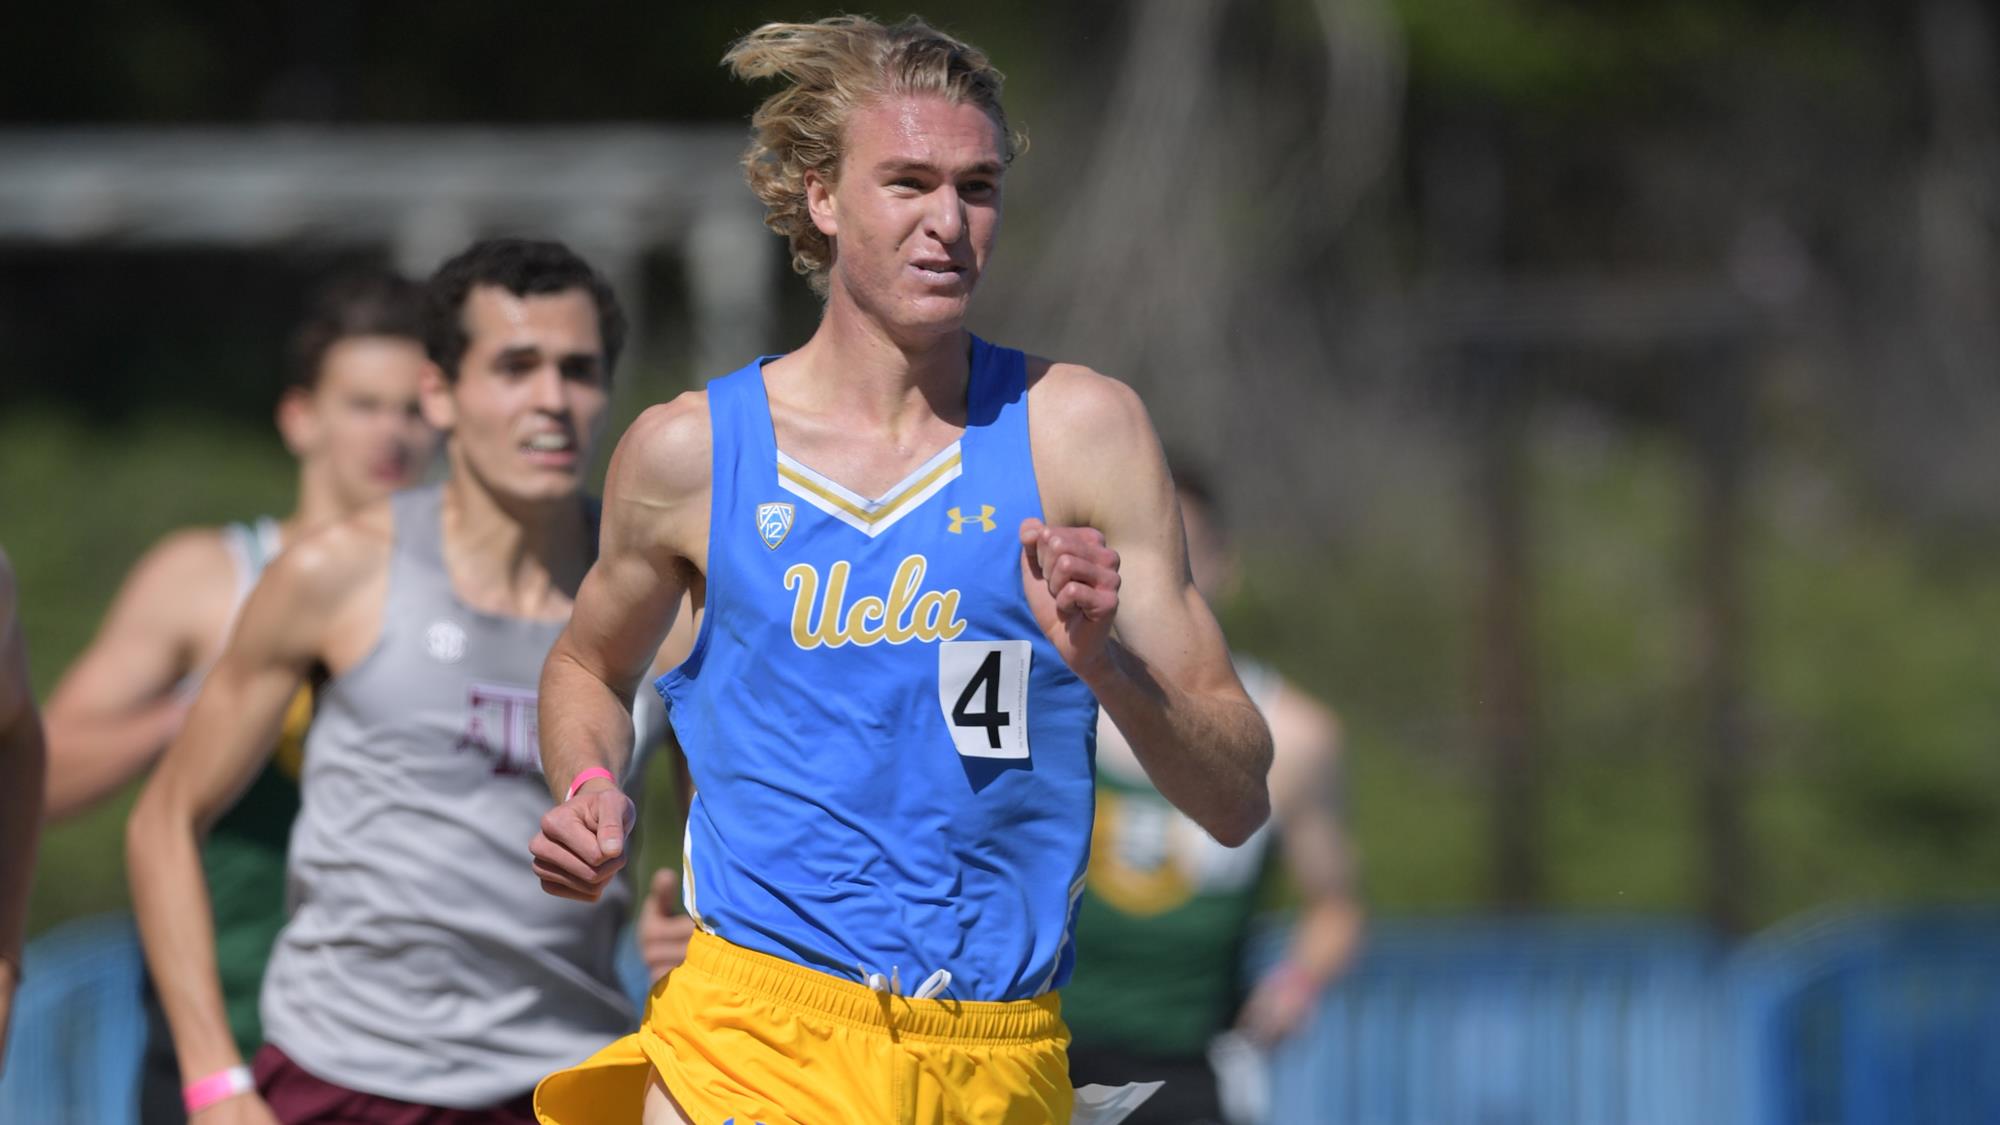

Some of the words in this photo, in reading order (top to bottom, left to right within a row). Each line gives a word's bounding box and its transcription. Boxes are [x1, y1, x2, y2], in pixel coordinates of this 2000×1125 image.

[759, 505, 792, 529] PAC
[766, 522, 782, 539] 12
[952, 650, 1010, 749] 4
